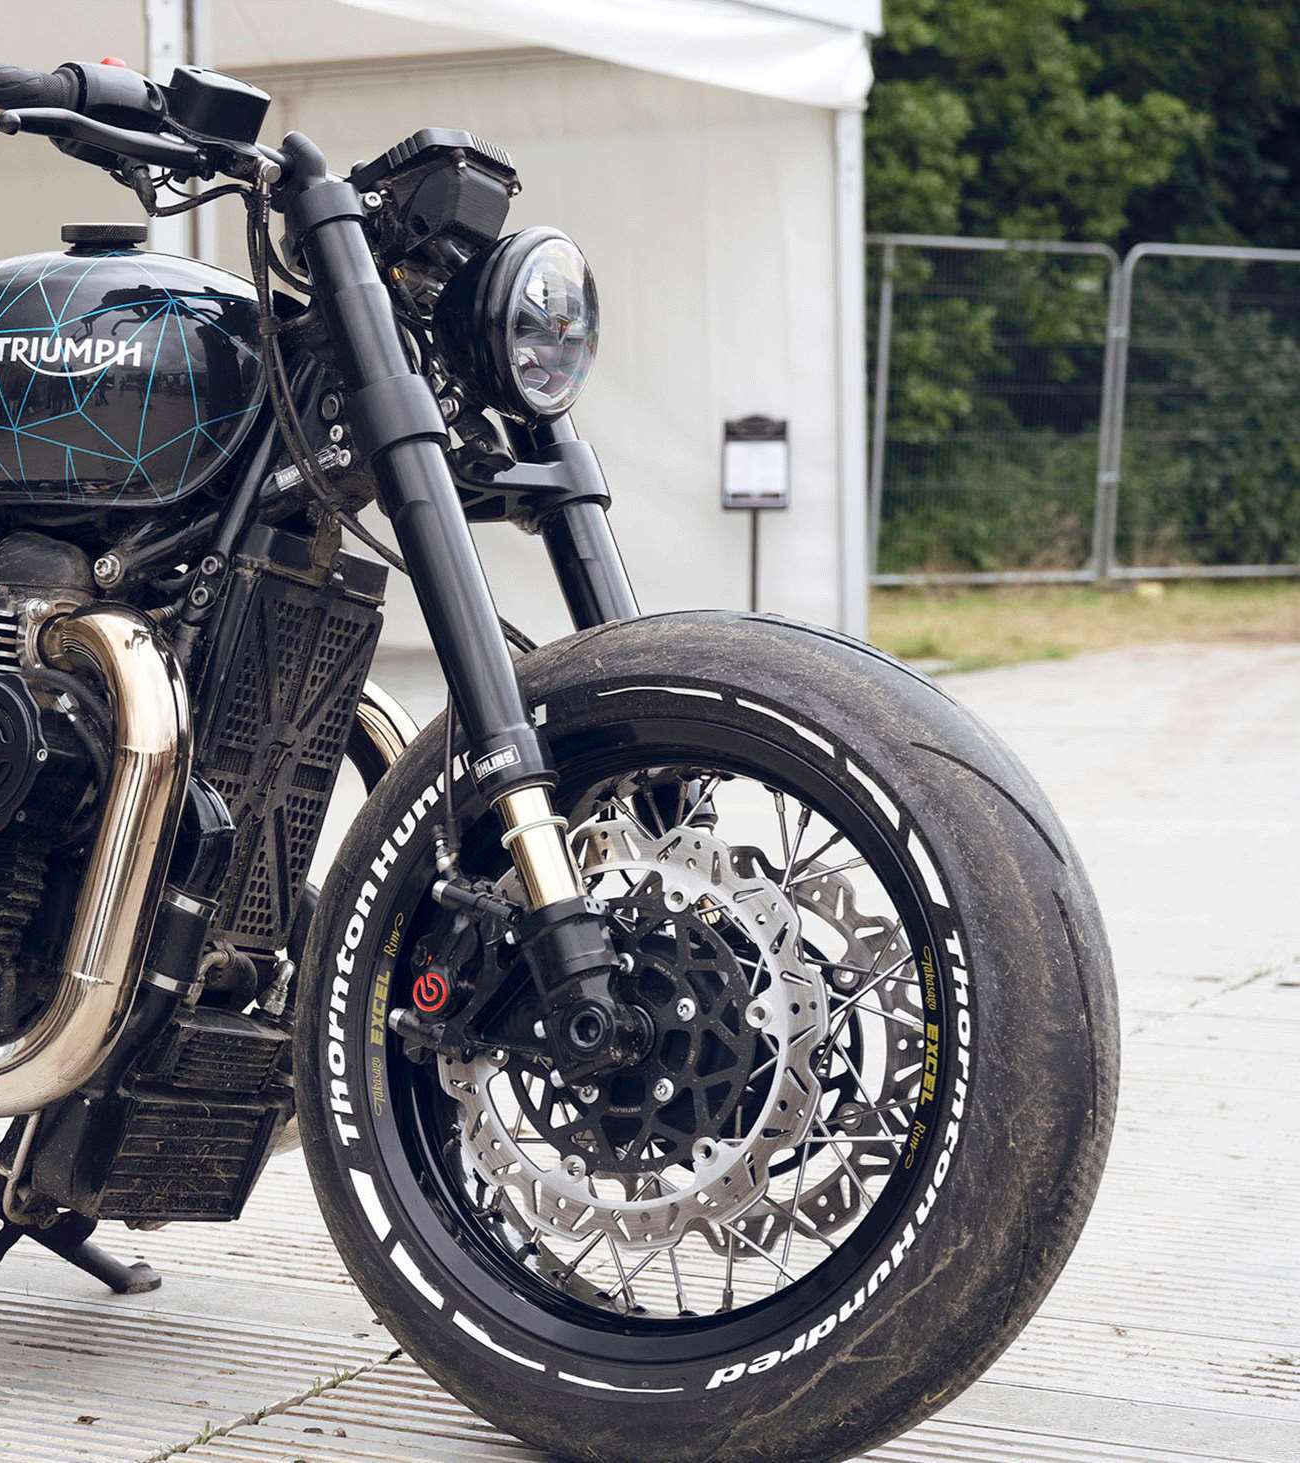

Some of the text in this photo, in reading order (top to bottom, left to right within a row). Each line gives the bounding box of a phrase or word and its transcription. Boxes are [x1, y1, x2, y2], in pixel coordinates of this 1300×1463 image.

[474, 750, 515, 779] ÖHLINS
[328, 880, 378, 1146] Thornton
[370, 970, 391, 1047] EXCEL
[920, 1023, 940, 1106] EXCEL
[705, 930, 971, 1390] Thornton Hundred
